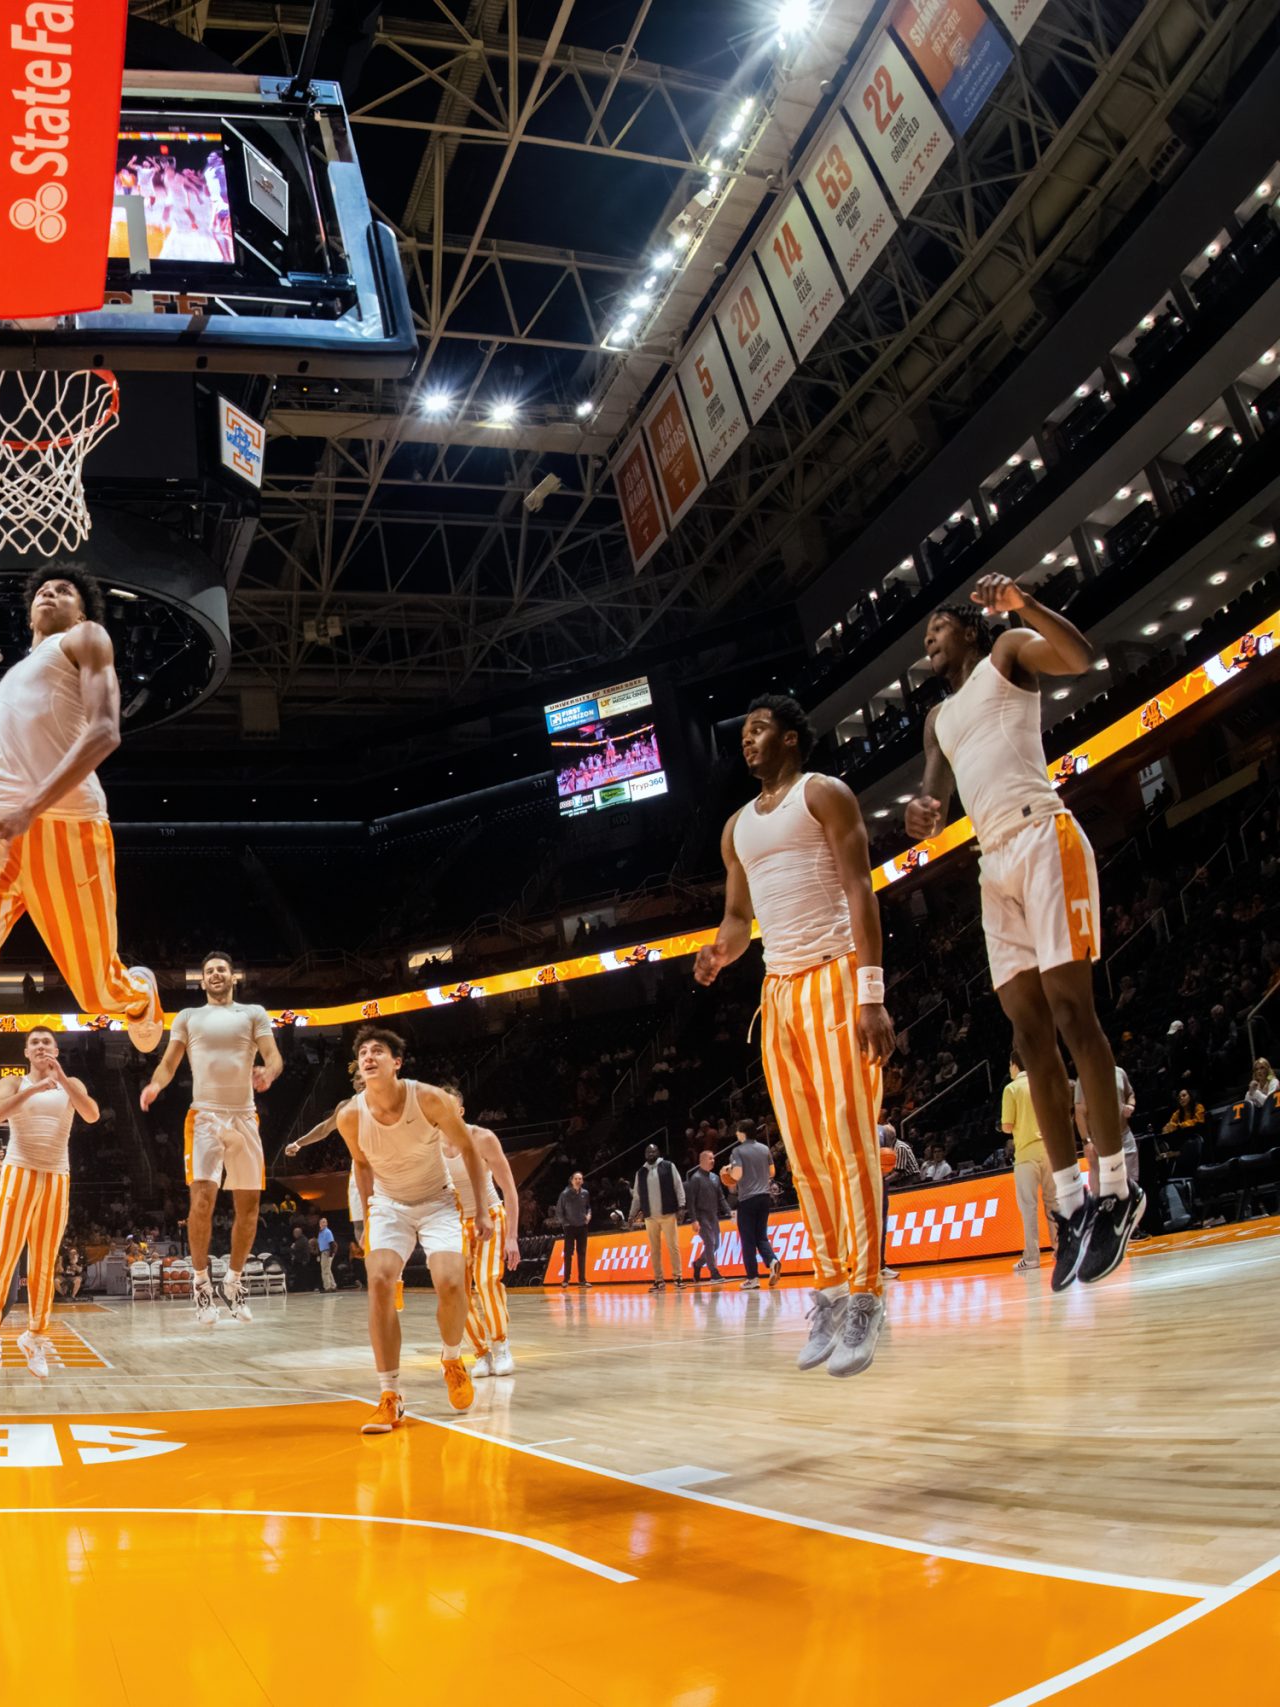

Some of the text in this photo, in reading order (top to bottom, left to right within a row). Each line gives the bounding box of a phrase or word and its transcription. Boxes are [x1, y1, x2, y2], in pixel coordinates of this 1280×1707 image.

[863, 65, 904, 135] 22
[889, 112, 908, 143] ERNIE
[890, 116, 920, 163] GRUNFELD
[816, 144, 852, 209] 53
[913, 153, 925, 173] T
[835, 186, 861, 227] BERNARD
[845, 206, 861, 231] KING
[773, 222, 803, 279] 14
[860, 232, 871, 251] T
[793, 267, 808, 291] DALE
[797, 279, 813, 304] ELLIS
[730, 286, 760, 348] 20
[809, 305, 820, 323] T
[694, 354, 714, 399] 5
[658, 410, 674, 444] RAY
[658, 424, 686, 472] MEARS
[562, 707, 580, 717] FIRST
[562, 709, 594, 723] HORIZON
[631, 778, 664, 792] Tryp360
[1071, 898, 1091, 936] T
[1, 1067, 25, 1077] 12:54
[1232, 1103, 1244, 1120] T
